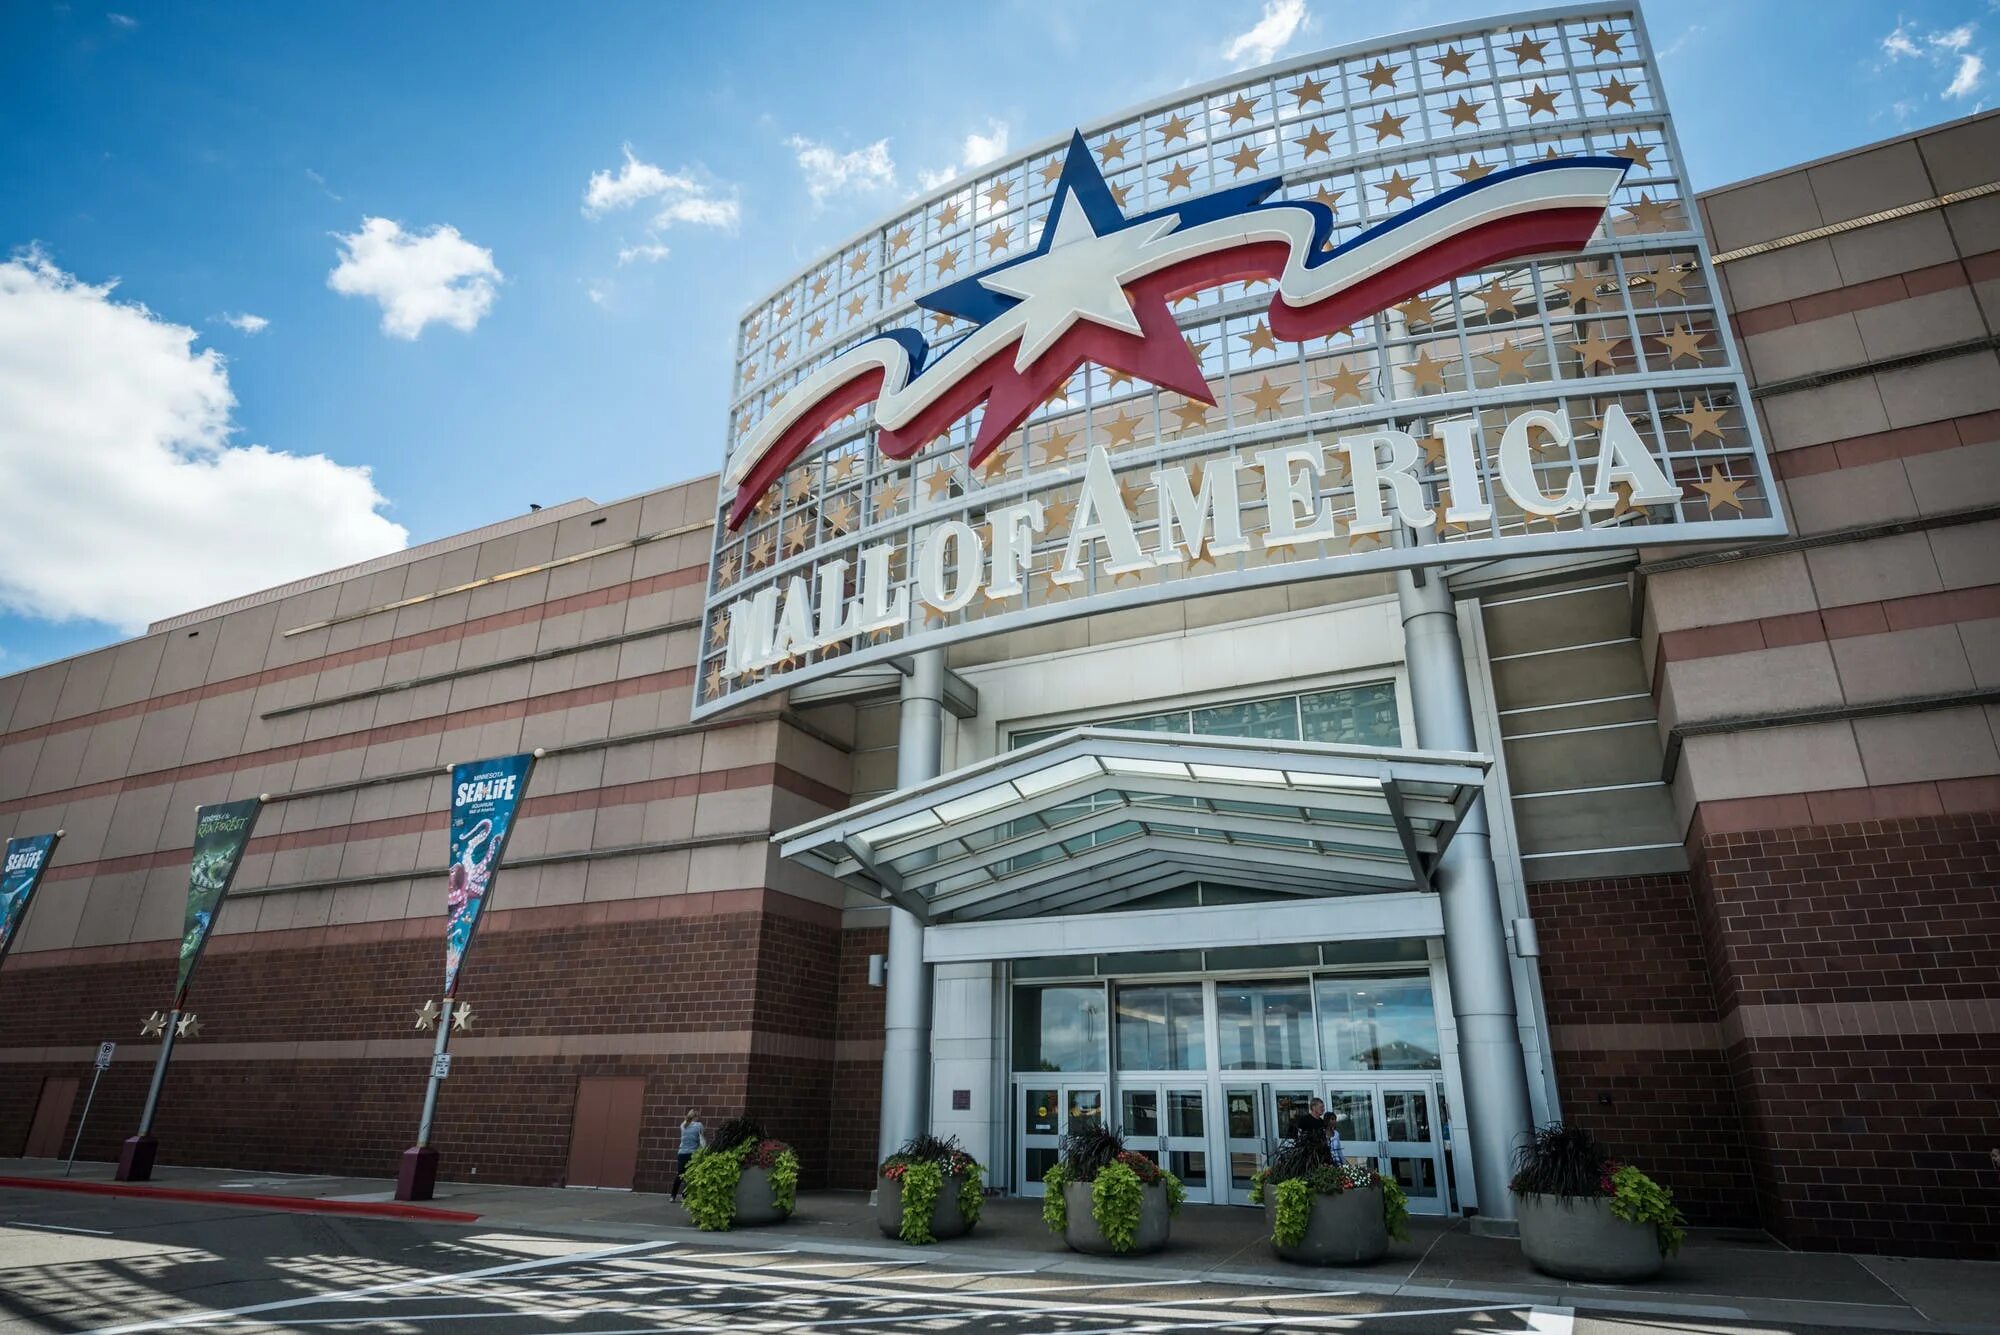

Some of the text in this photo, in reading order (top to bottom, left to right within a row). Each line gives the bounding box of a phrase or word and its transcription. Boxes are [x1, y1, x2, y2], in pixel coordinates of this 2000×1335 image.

[719, 404, 1684, 679] MALL OF AMERICA
